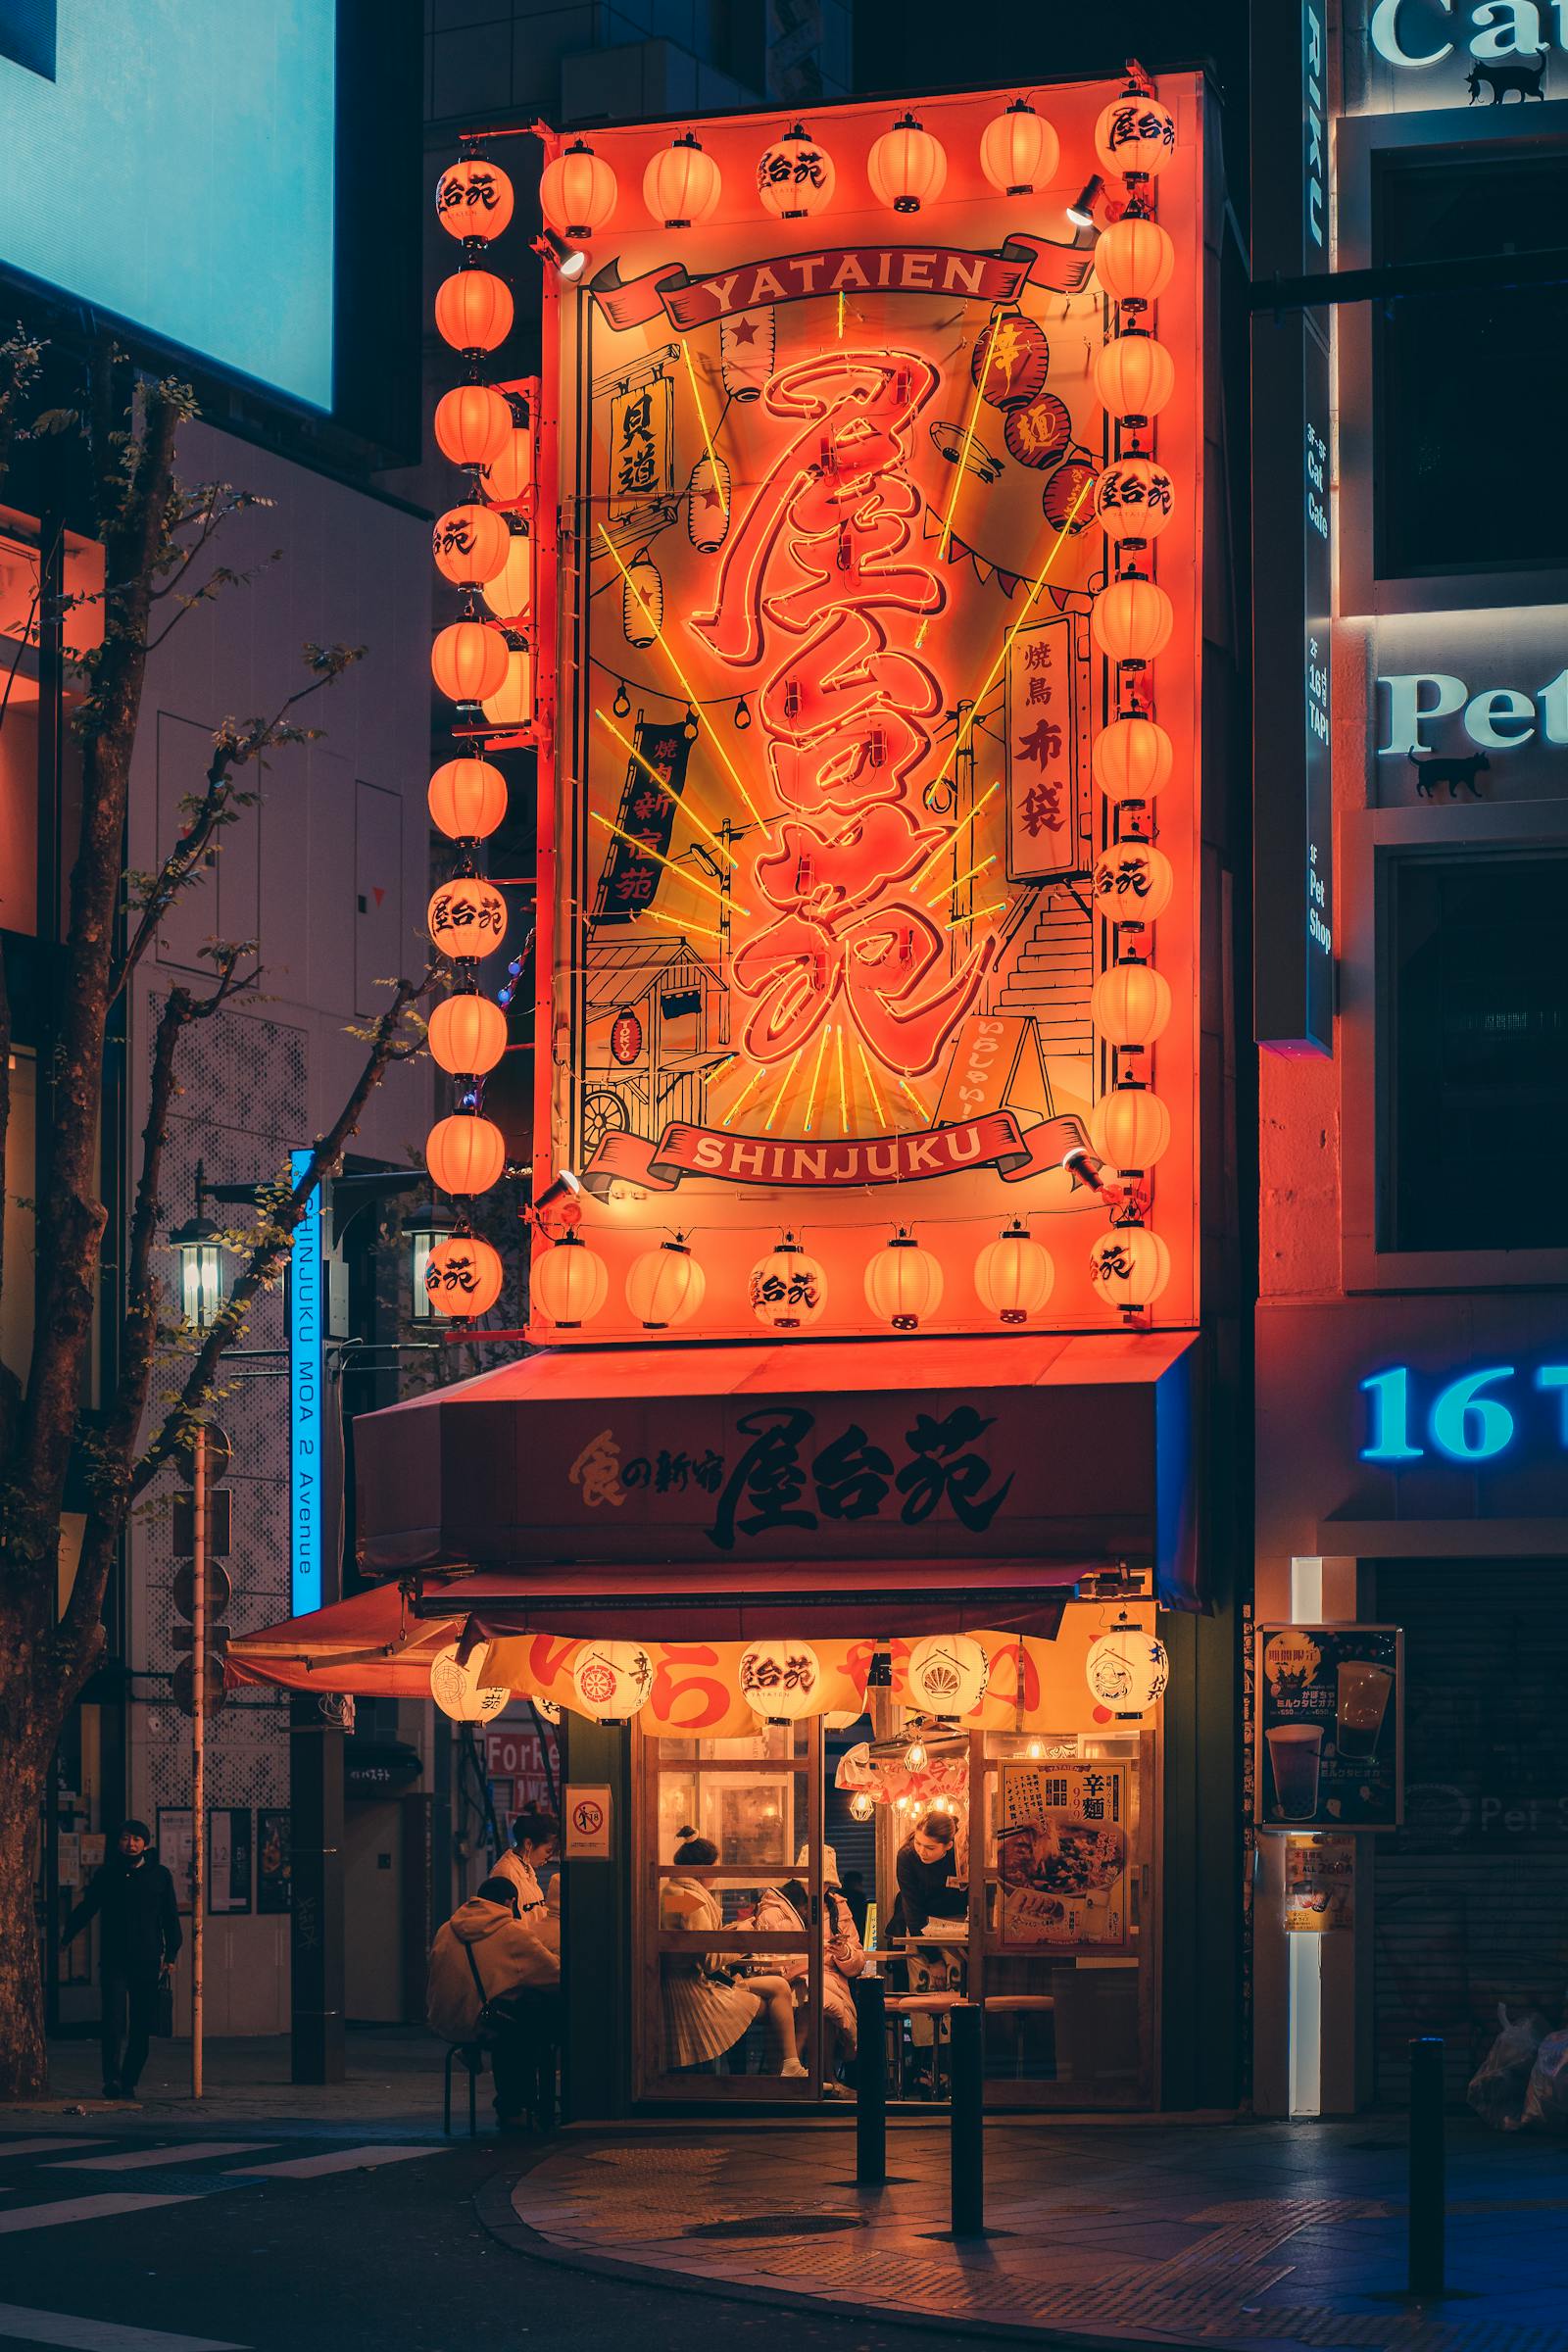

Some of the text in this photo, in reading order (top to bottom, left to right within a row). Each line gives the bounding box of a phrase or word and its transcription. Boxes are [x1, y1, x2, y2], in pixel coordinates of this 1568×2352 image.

[1372, 0, 1568, 69] Ca
[702, 252, 987, 313] YATAIEN
[617, 393, 660, 495] 貝道
[1308, 450, 1324, 494] Cat
[1308, 491, 1328, 539] Cafe
[1309, 637, 1318, 660] 2F
[1013, 641, 1067, 839] 焼鳥布袋
[1308, 699, 1330, 747] TAPI
[1309, 843, 1318, 865] 1F
[1309, 868, 1325, 908] Pet
[431, 894, 505, 938] 屋台苑
[1309, 906, 1332, 956] Shop
[619, 1019, 631, 1059] TOKYO
[692, 1127, 982, 1181] SHINJUKU
[298, 1360, 315, 1422] MOA
[1365, 1366, 1515, 1458] 16
[298, 1439, 315, 1456] 2
[298, 1471, 315, 1575] Avenue
